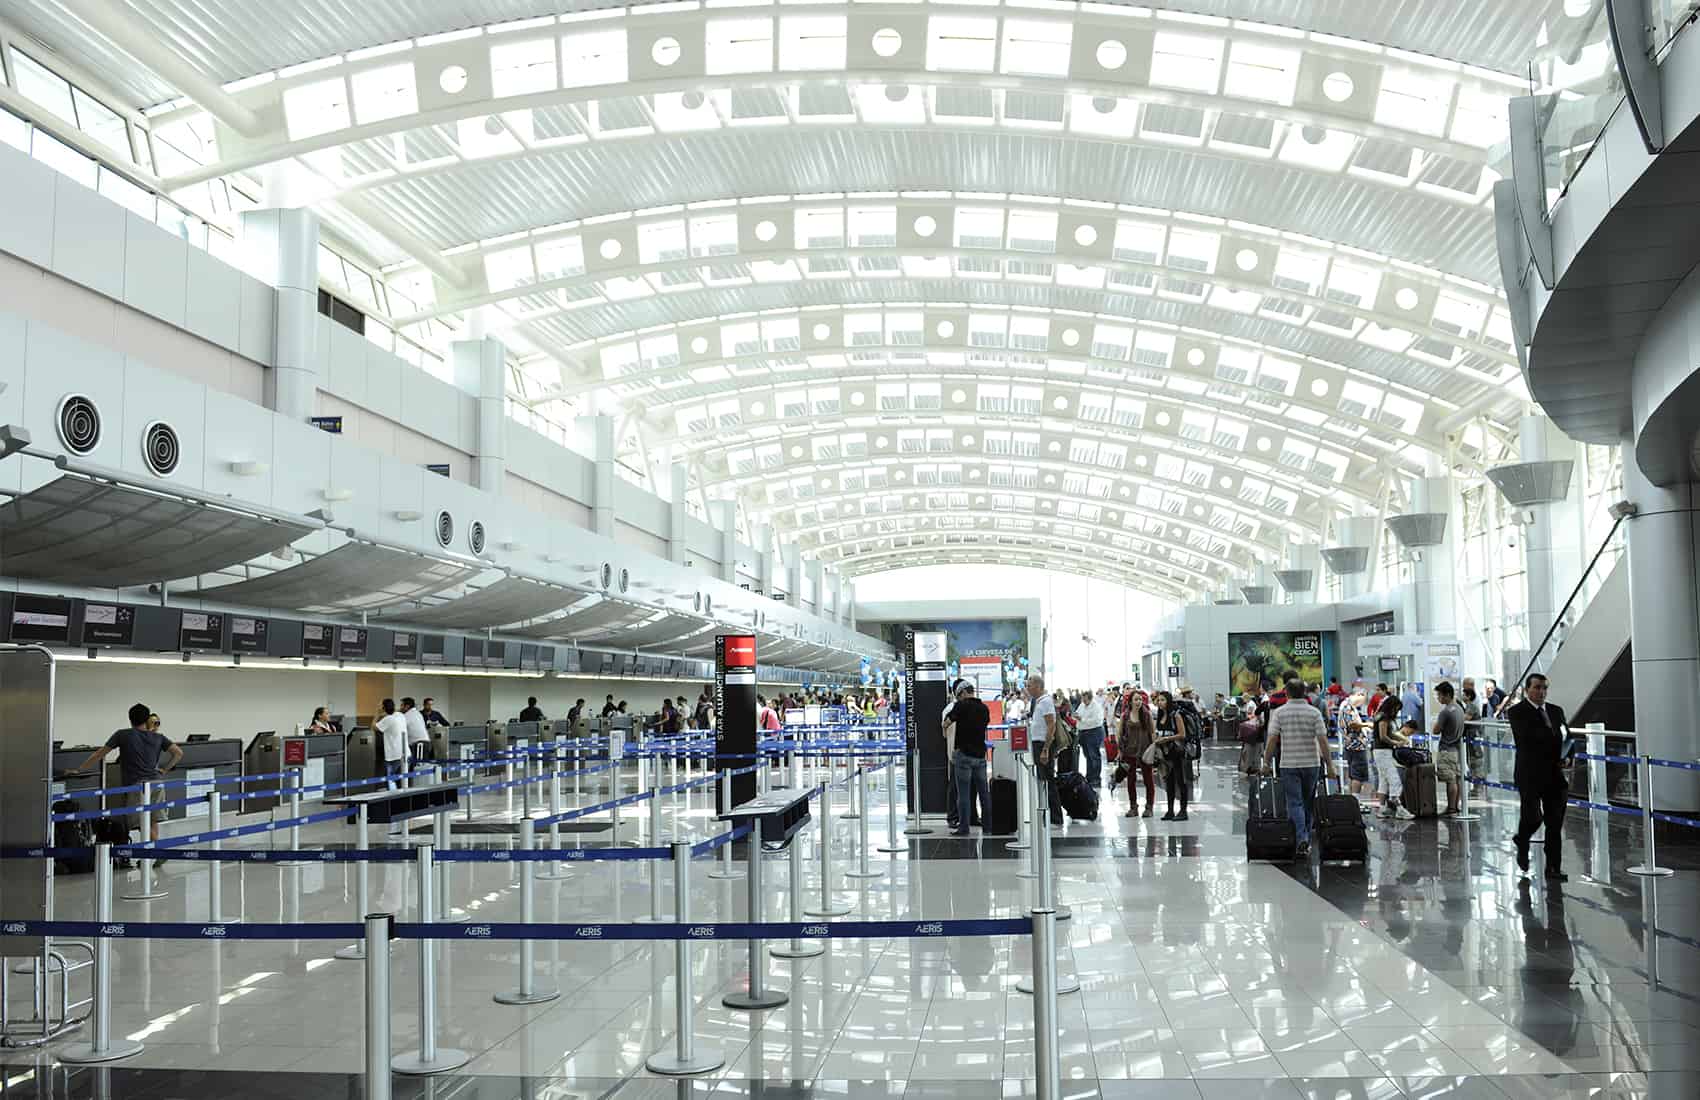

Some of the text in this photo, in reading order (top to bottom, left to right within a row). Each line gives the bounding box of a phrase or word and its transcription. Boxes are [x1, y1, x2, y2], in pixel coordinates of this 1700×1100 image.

[1295, 640, 1318, 649] BIEN
[906, 669, 914, 713] ALLIANCE
[907, 715, 915, 738] STAR
[3, 922, 27, 933] AERIS
[100, 924, 125, 935] AERIS
[201, 926, 227, 936] AERIS
[464, 926, 491, 936] AERIS
[575, 926, 602, 936] AERIS
[687, 927, 715, 936] AERIS
[800, 925, 829, 935] AERIS
[914, 923, 944, 934] AERIS
